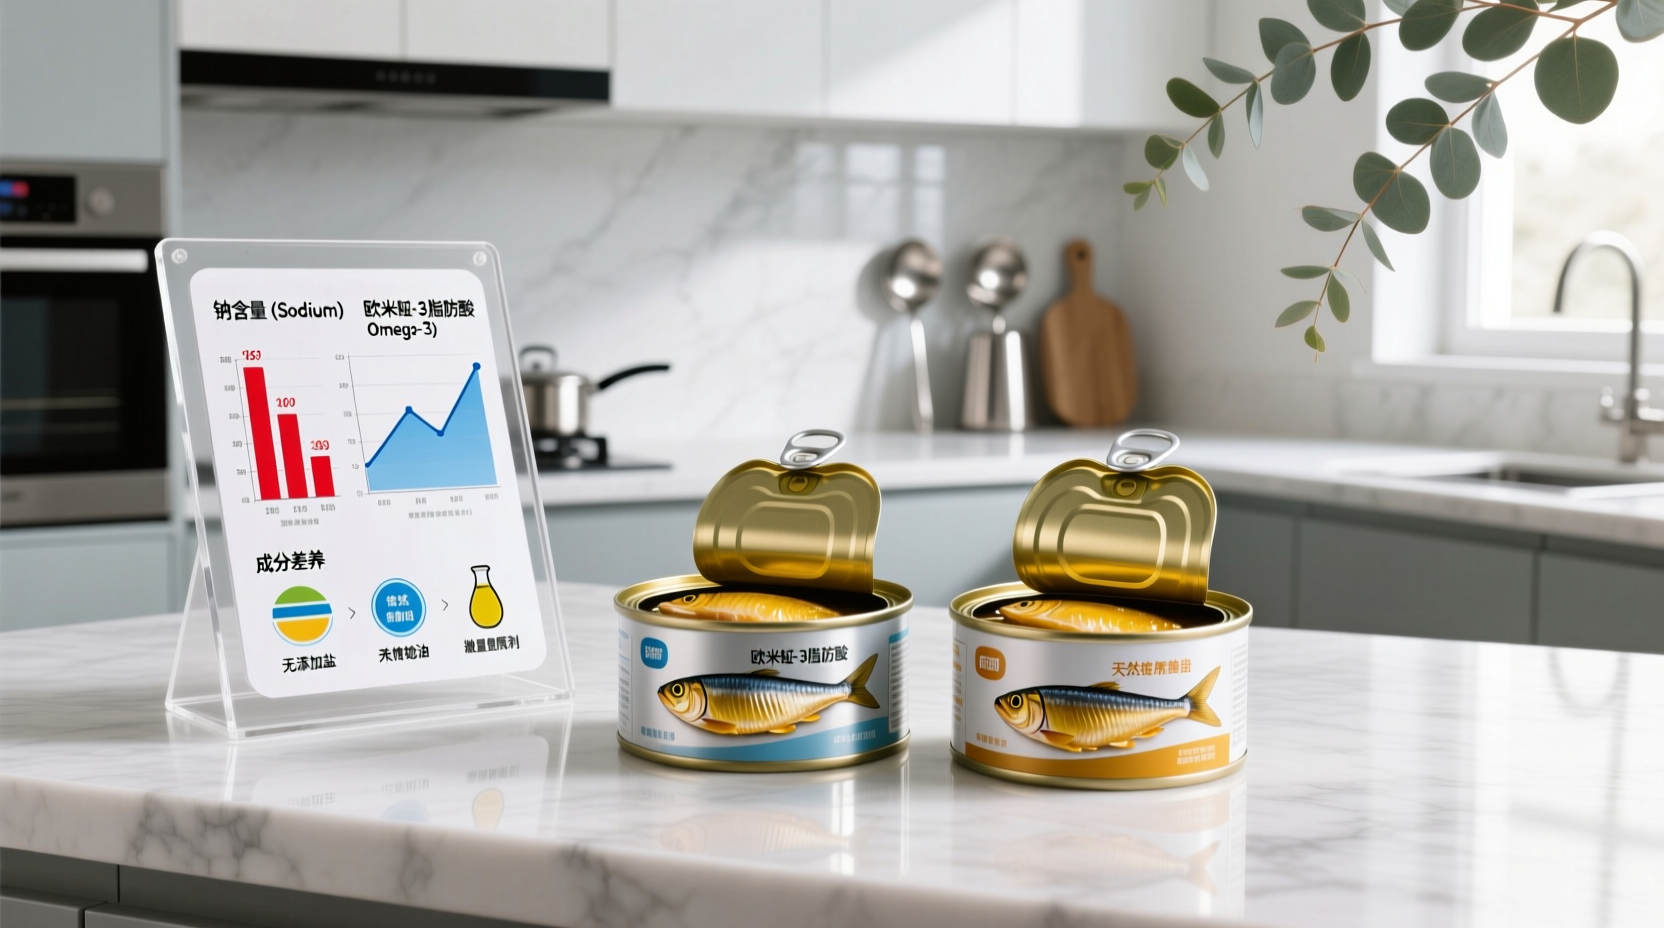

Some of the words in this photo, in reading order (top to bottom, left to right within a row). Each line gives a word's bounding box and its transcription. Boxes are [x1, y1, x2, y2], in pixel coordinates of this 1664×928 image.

[213, 299, 268, 320] 钠含量
[271, 300, 344, 321] (Sodium)
[282, 653, 337, 673] 无添加盐
